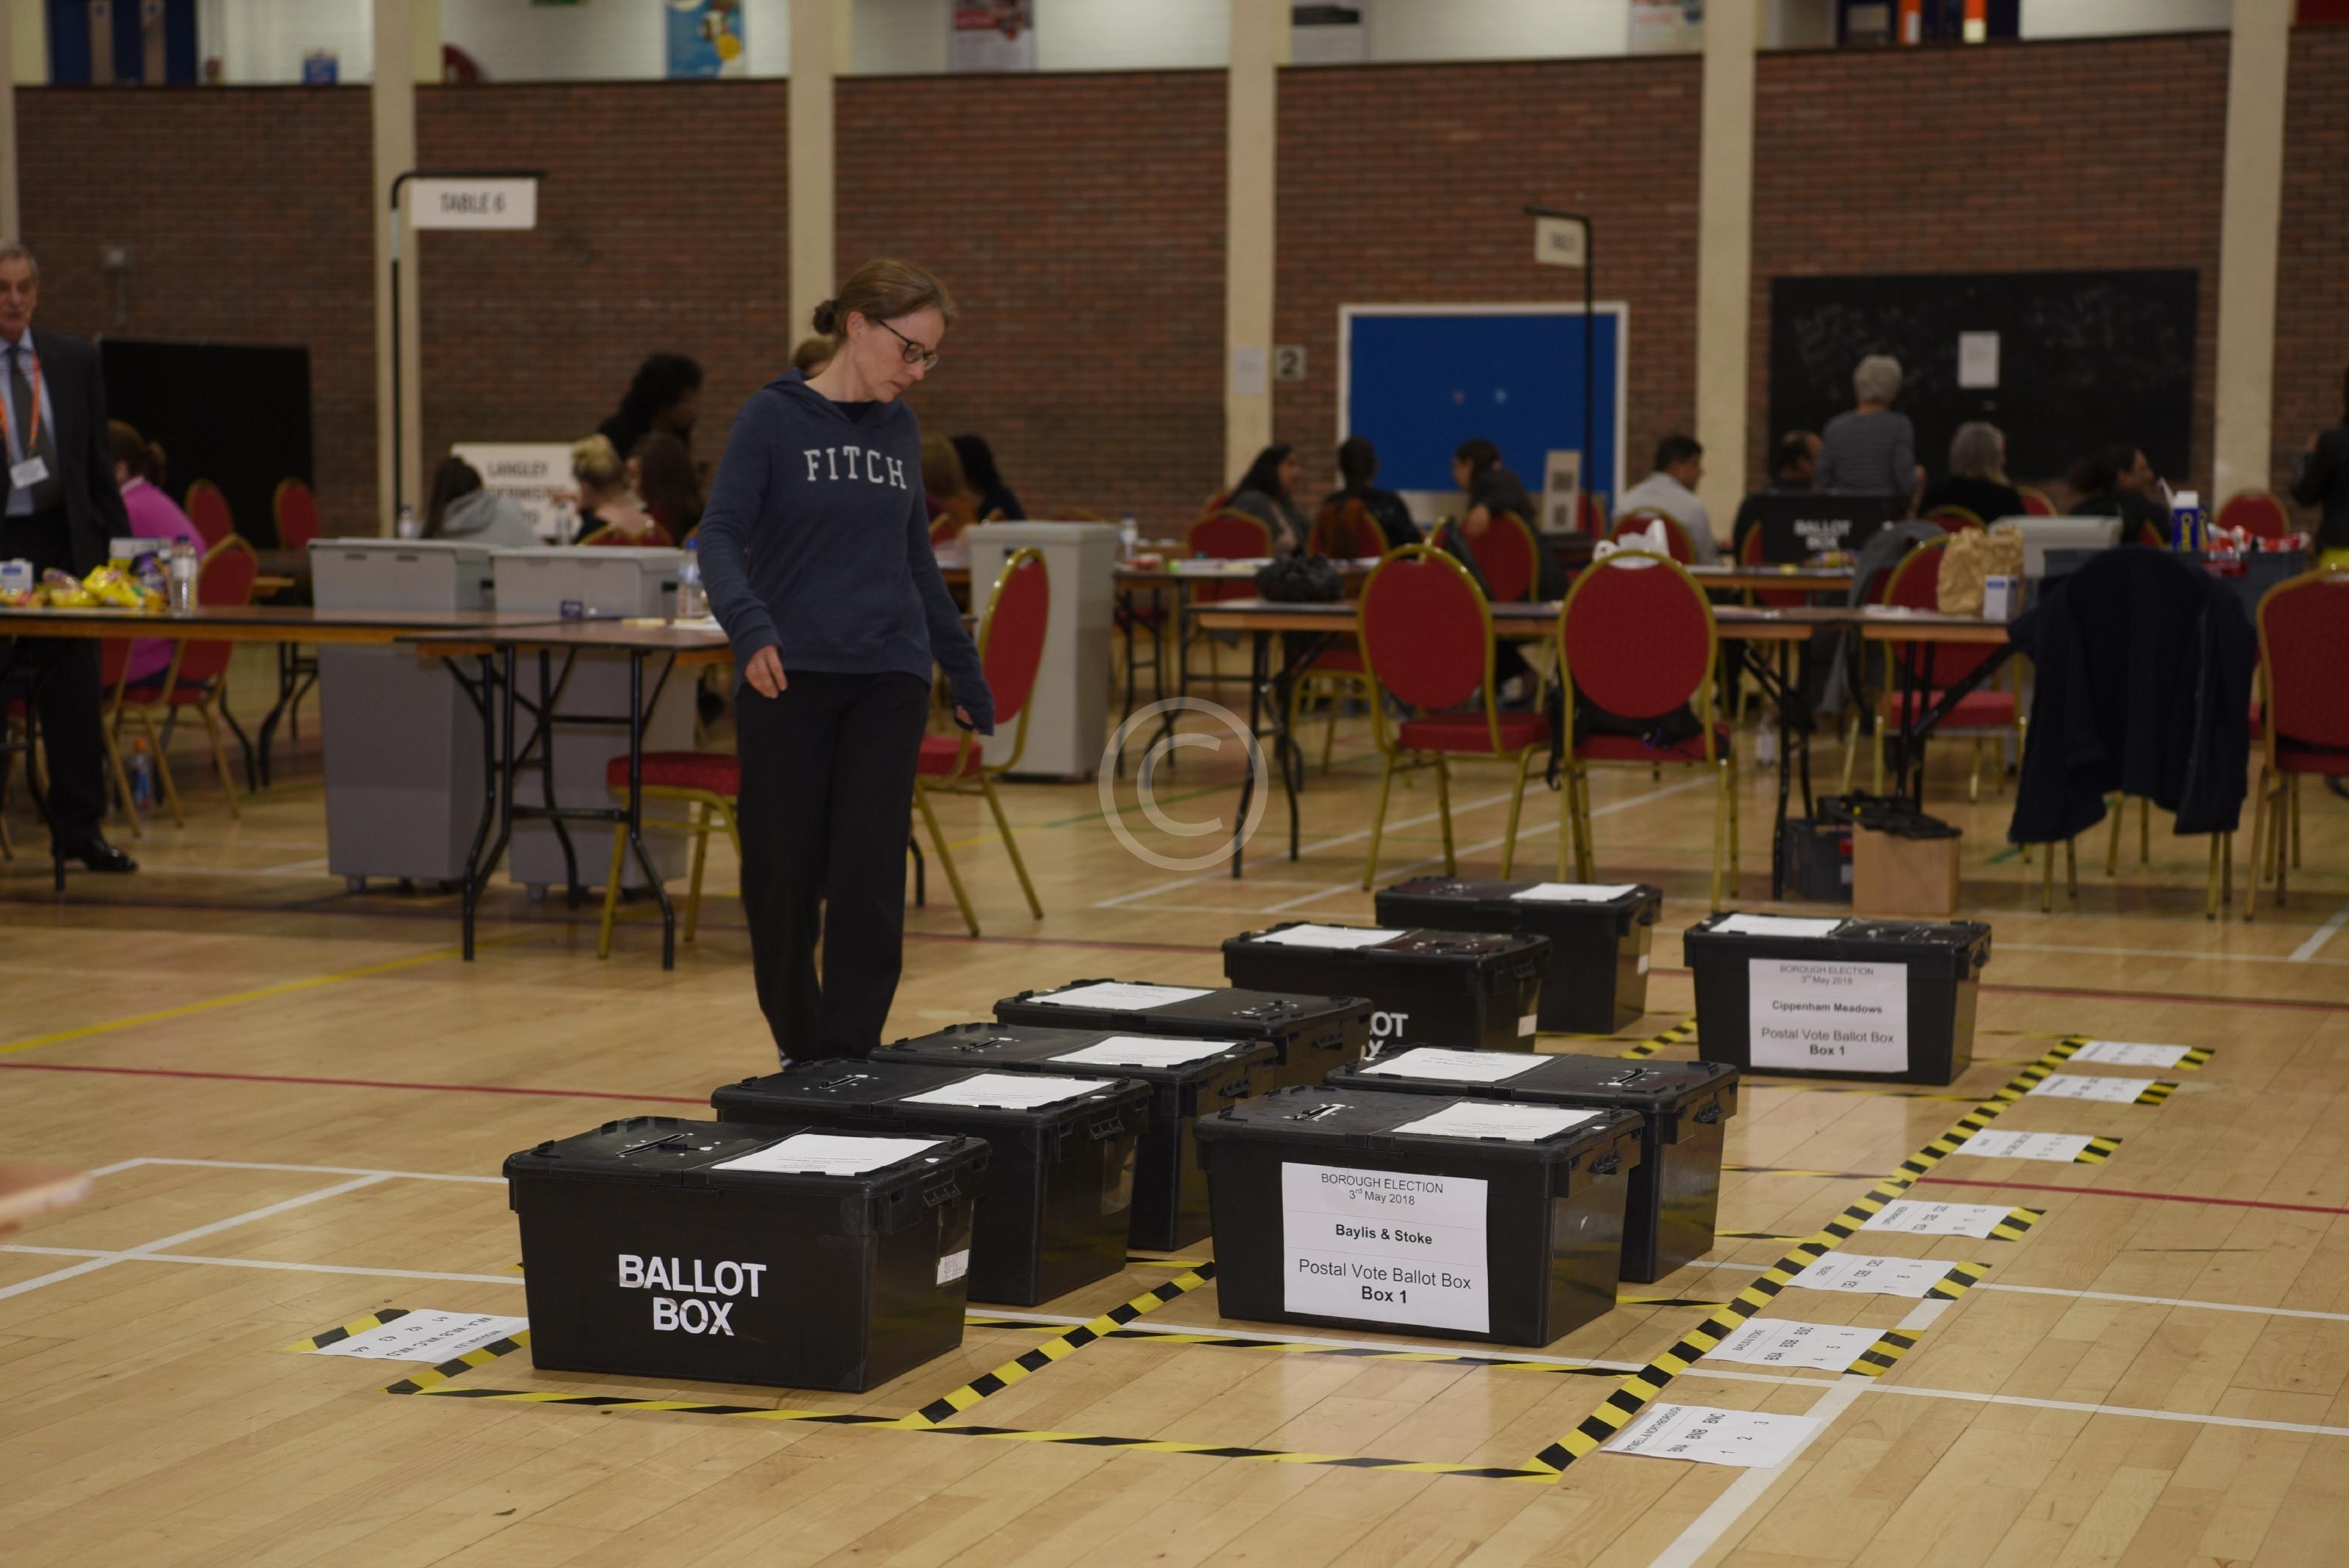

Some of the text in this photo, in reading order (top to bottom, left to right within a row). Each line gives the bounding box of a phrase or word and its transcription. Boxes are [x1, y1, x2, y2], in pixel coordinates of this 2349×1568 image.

[440, 192, 491, 214] TABLE
[1279, 350, 1299, 377] 2
[487, 460, 550, 476] LANGLEY
[802, 445, 907, 490] FITCH
[1779, 964, 1874, 976] BOROUGH ELECTION
[1812, 976, 1830, 986] May
[1772, 1000, 1883, 1014] Cippenham Meadows
[1761, 1027, 1895, 1044] Postal Vote Ballot Box
[1809, 1044, 1845, 1056] Box 1
[1321, 1173, 1444, 1194] BOROUGH ELECTION
[1365, 1191, 1387, 1205] May
[1389, 1194, 1415, 1205] 2018
[1335, 1224, 1432, 1245] Baylis & Stoke
[618, 1254, 767, 1299] BALLOT
[1299, 1258, 1472, 1290] Postal Vote Ballot Box
[1362, 1286, 1407, 1304] Box 1
[653, 1296, 735, 1337] BOX
[385, 1316, 495, 1357] WLA WLB WLC WLD
[1762, 1326, 1815, 1362] BSA BSB BSC
[1684, 1428, 1709, 1440] BNB
[1701, 1412, 1727, 1425] BNC
